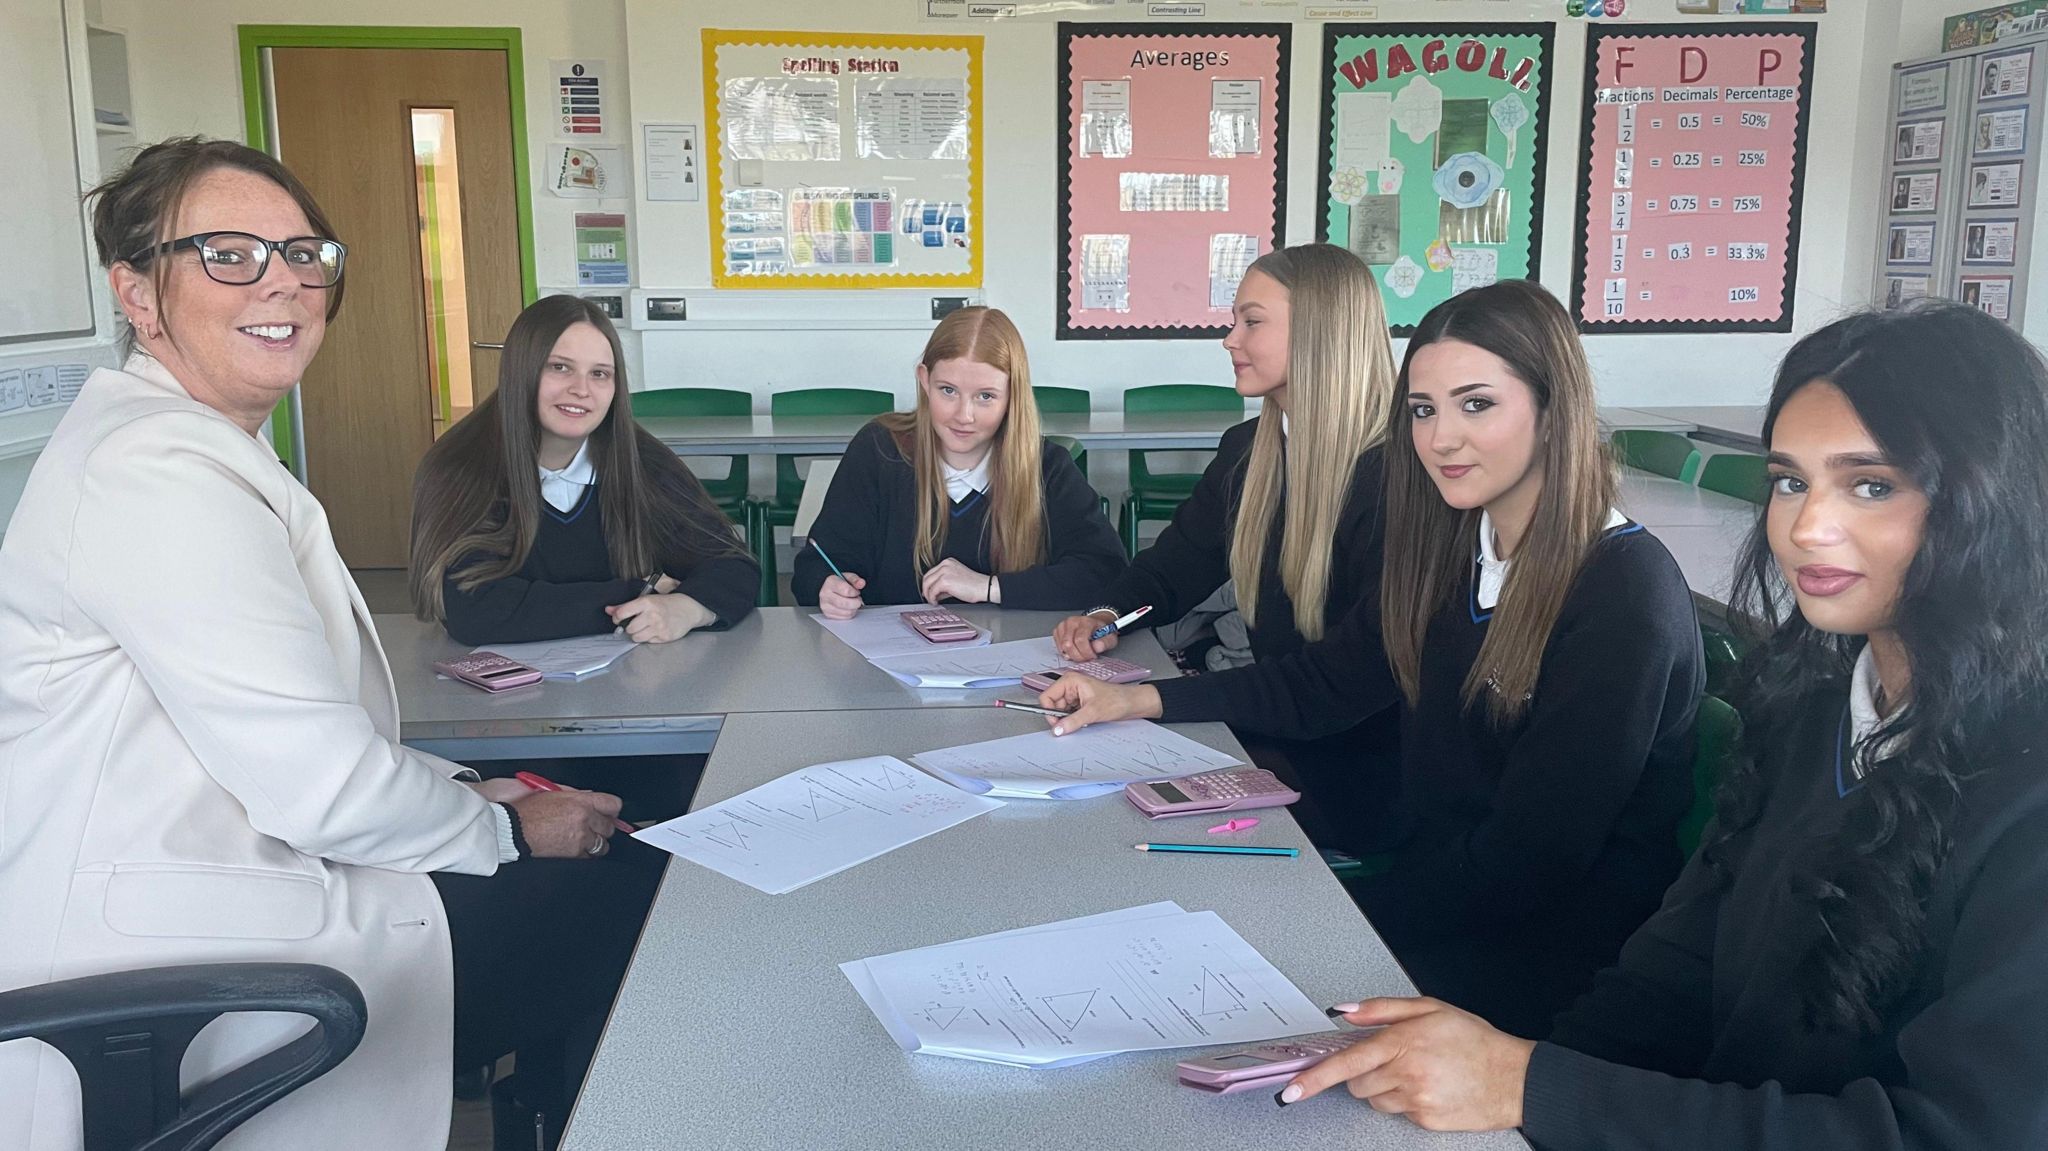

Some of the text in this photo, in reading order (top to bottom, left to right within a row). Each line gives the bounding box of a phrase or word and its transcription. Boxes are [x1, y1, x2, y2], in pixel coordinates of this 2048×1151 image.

[1151, 6, 1187, 14] Contrasting
[782, 57, 899, 74] Spelling Station
[1131, 49, 1229, 70] Averages
[1615, 47, 1782, 85] F D P
[1663, 88, 1718, 102] Decimals
[1725, 87, 1793, 101] Percentage
[1680, 115, 1699, 128] 0.5
[1740, 112, 1767, 127] 50%
[1673, 153, 1700, 166] 0.25
[1739, 152, 1765, 165] 25%
[1670, 198, 1697, 211] 0.75
[1733, 198, 1760, 210] 75%
[1731, 289, 1756, 301] 10%
[1607, 303, 1623, 315] 10
